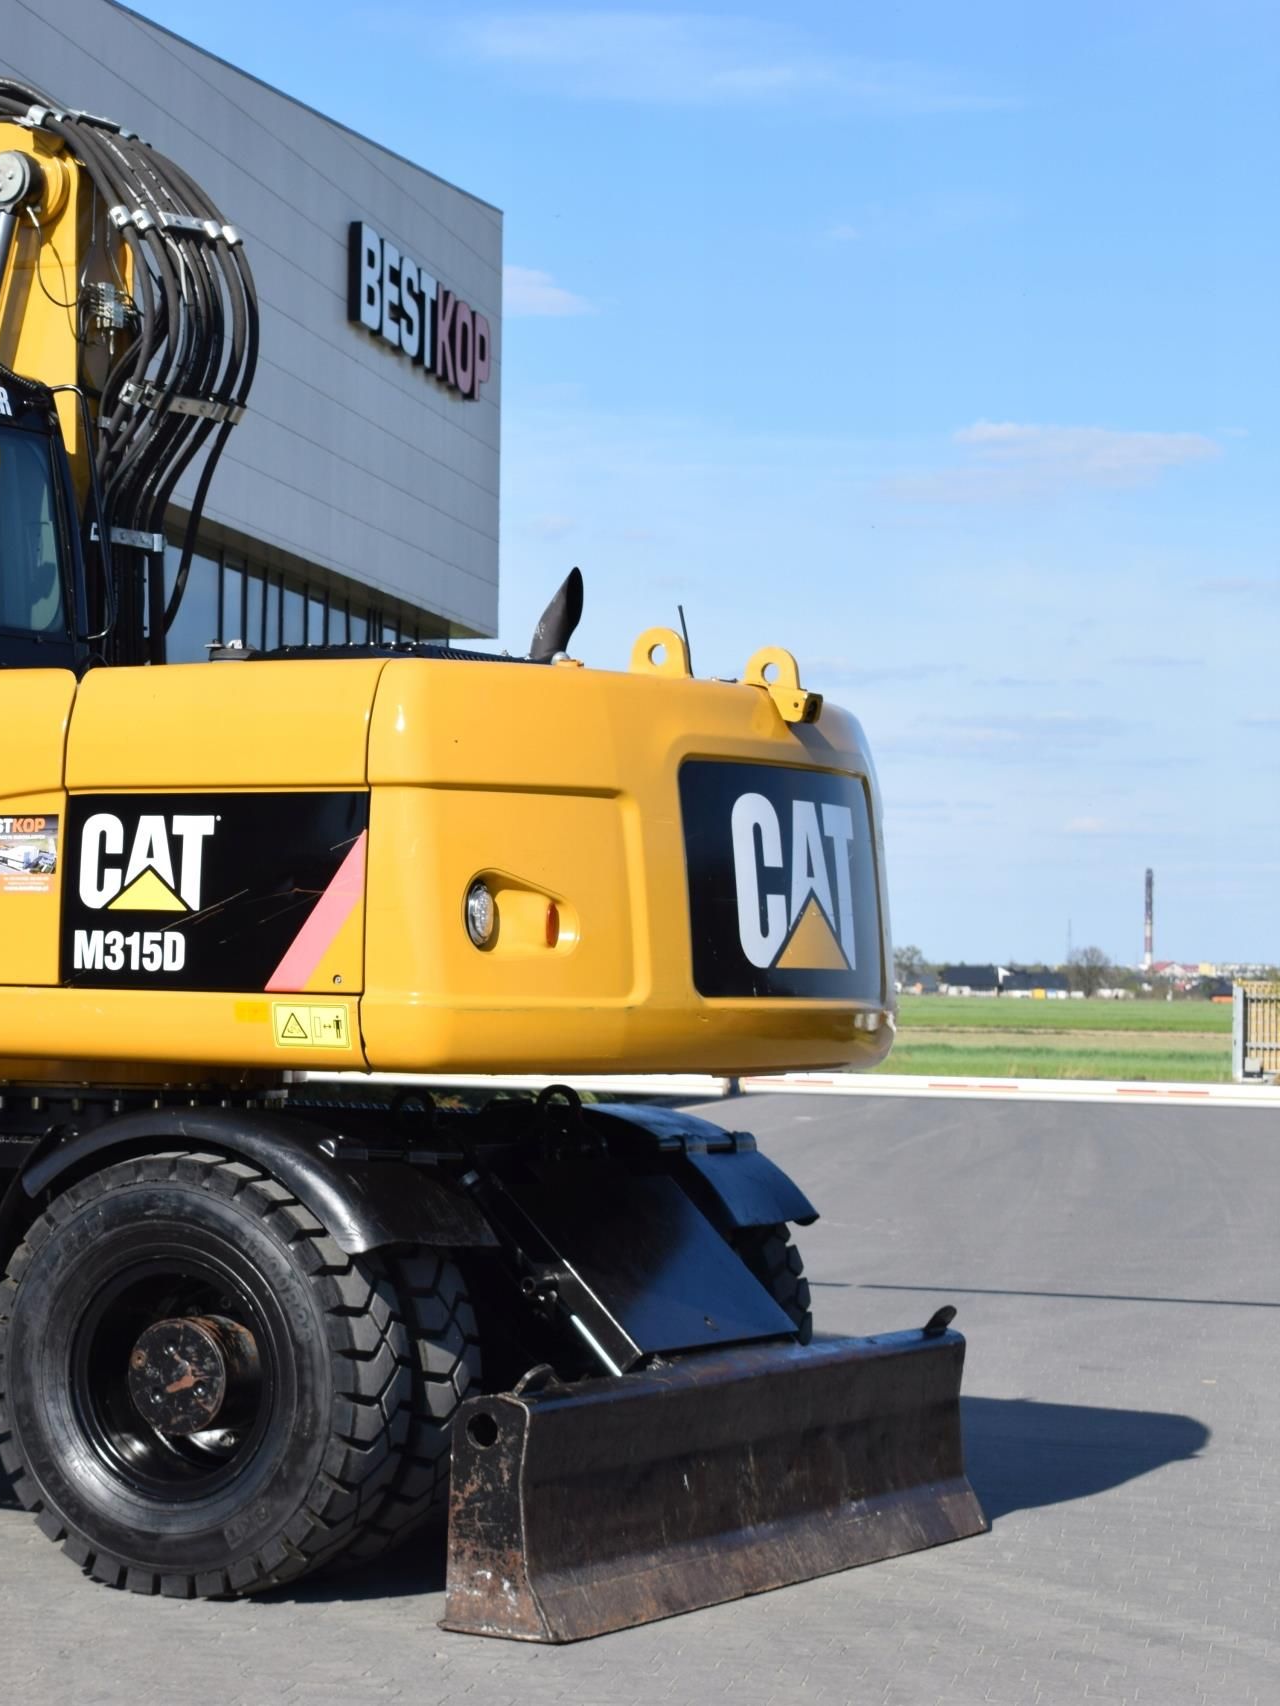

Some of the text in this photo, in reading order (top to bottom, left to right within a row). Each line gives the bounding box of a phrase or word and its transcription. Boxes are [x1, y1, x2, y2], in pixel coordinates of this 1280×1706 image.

[353, 221, 491, 402] BESTKOP
[79, 813, 216, 912] CAT
[731, 792, 857, 971] CAT
[73, 929, 186, 972] M315D
